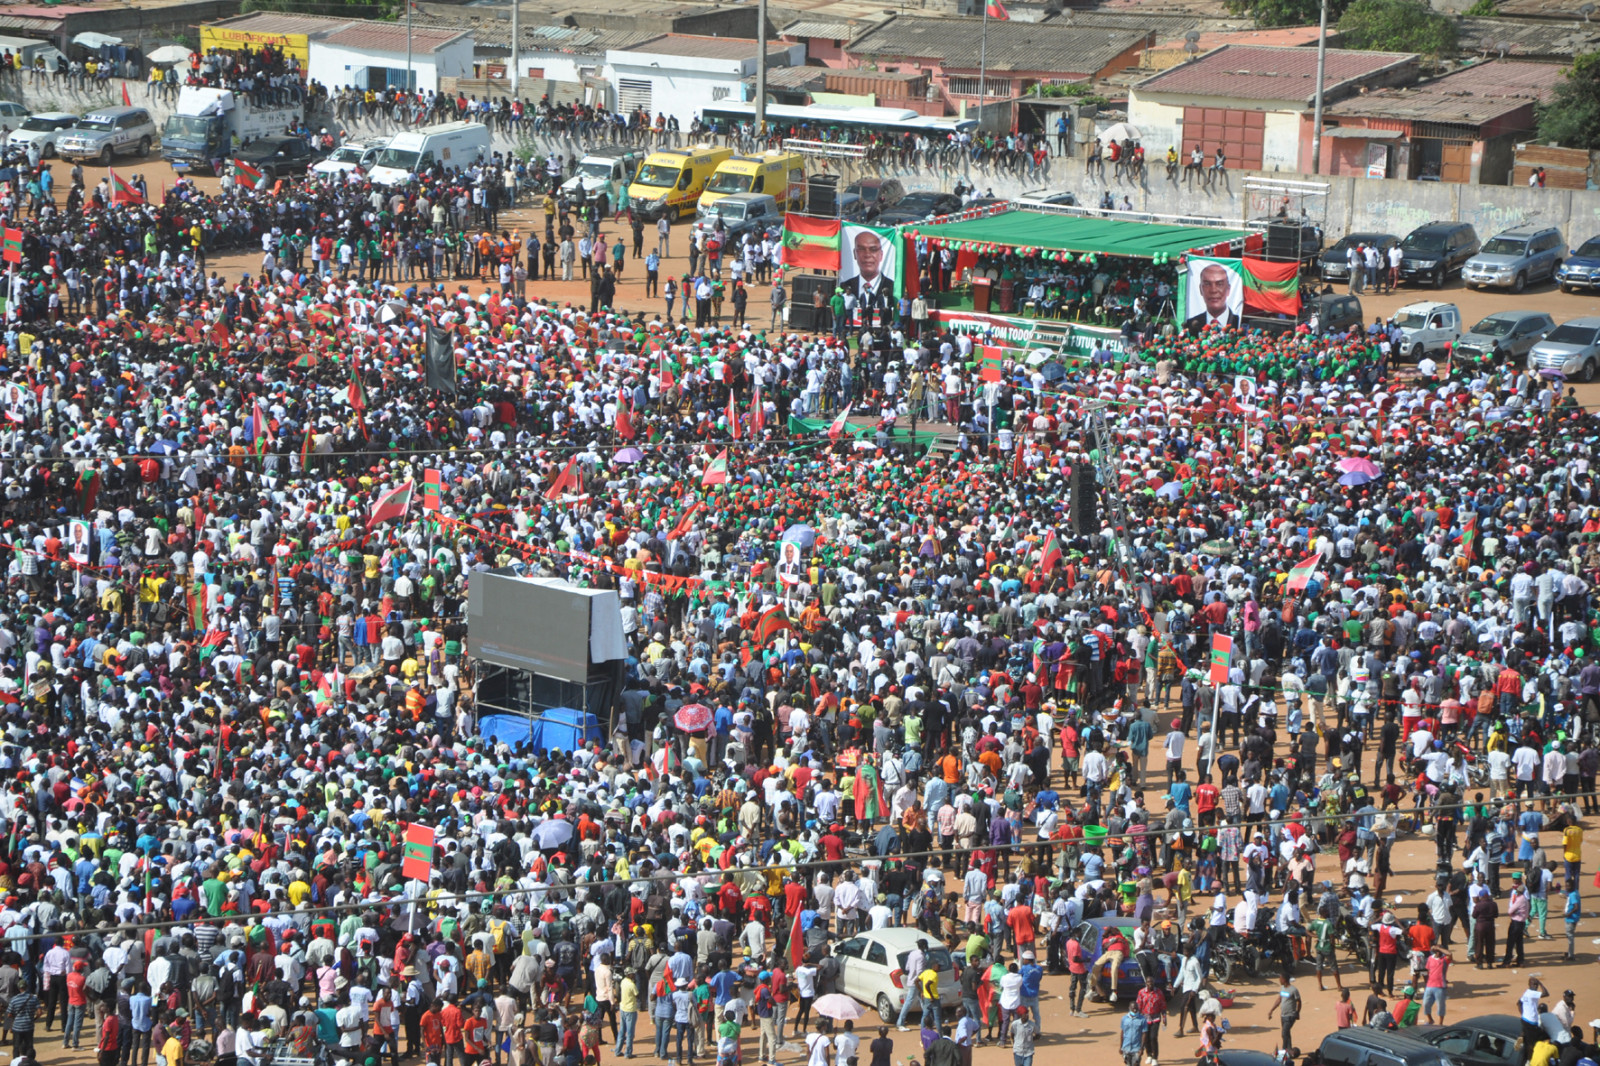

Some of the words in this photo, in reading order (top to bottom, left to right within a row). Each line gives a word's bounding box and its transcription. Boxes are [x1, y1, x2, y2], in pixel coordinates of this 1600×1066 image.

[952, 322, 985, 335] UNITA
[991, 325, 1007, 340] COM
[1070, 334, 1102, 350] FUTUR
[1101, 338, 1124, 353] MELH
